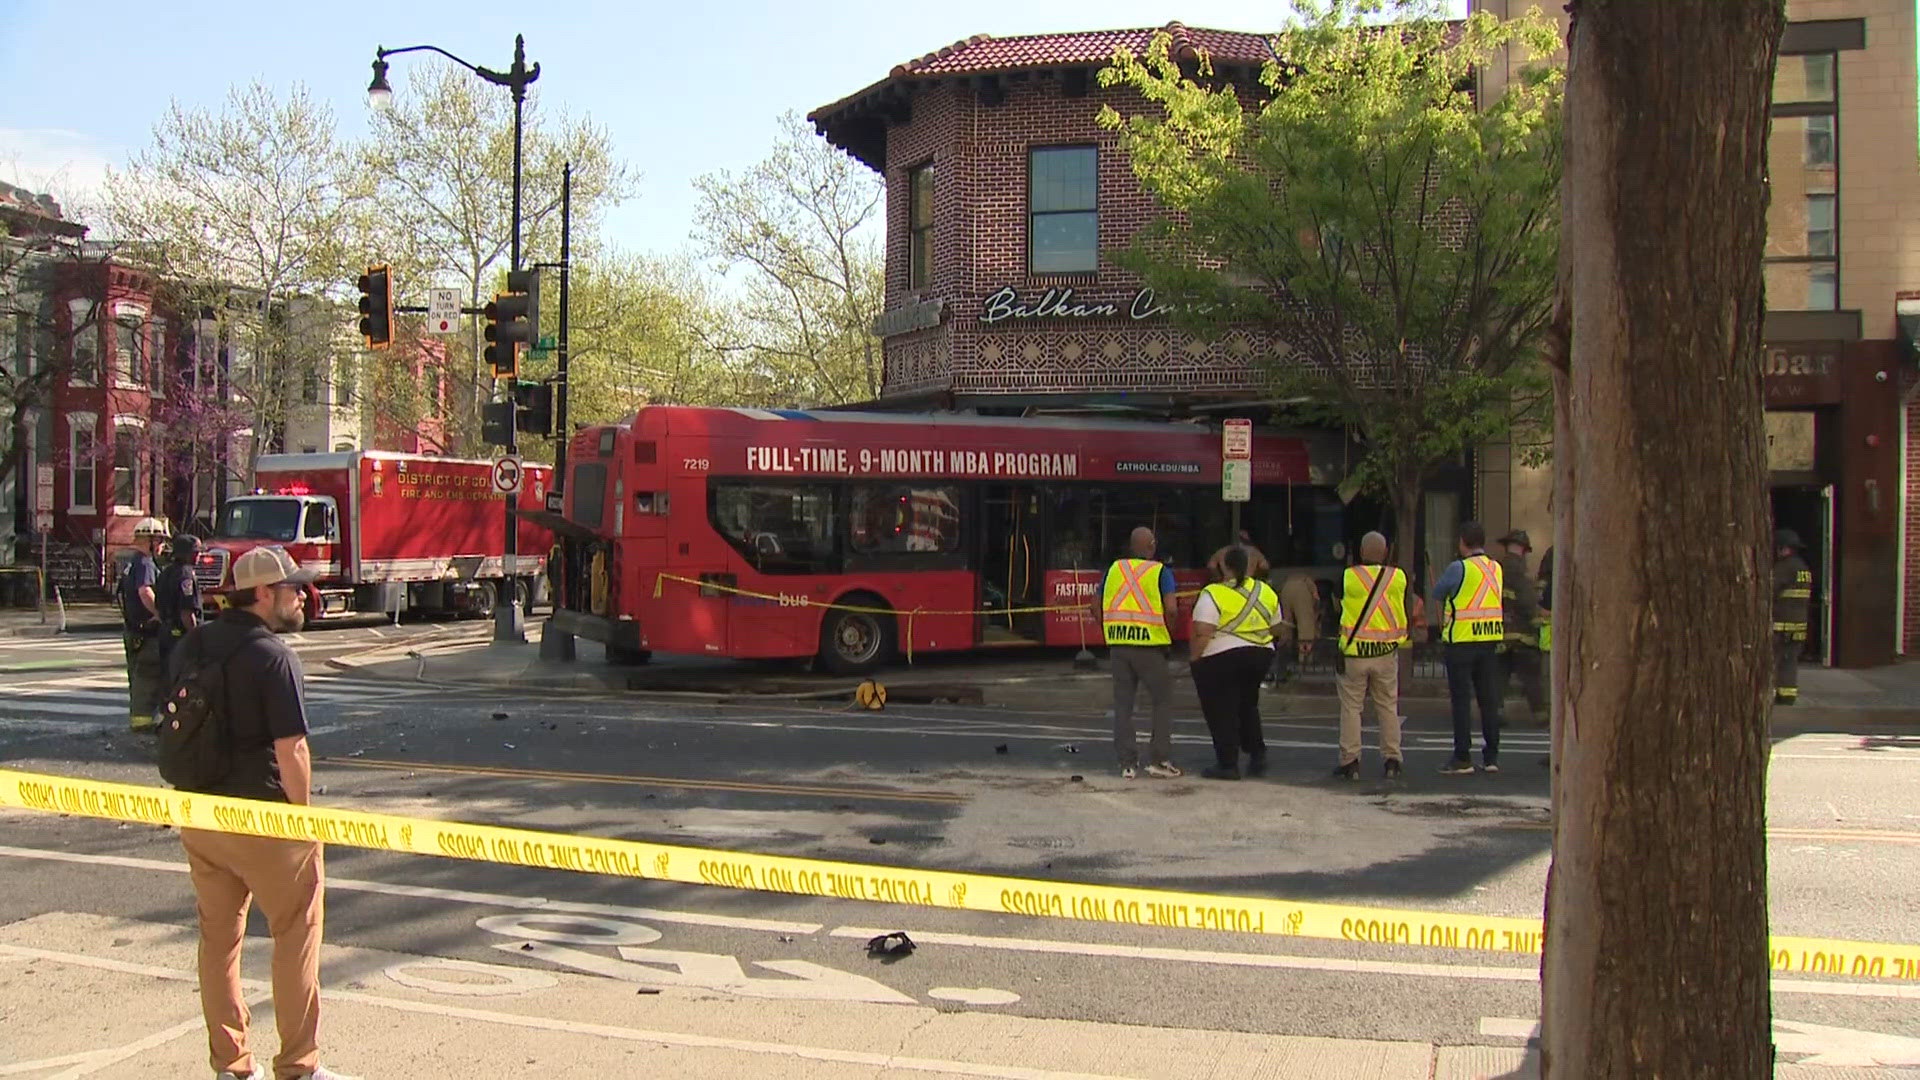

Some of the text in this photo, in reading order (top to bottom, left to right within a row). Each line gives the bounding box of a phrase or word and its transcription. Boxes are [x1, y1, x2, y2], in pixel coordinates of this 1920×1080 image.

[437, 301, 455, 311] TURN
[439, 291, 452, 301] NO
[979, 286, 1118, 323] Balkan
[430, 311, 458, 320] ON RED
[1766, 348, 1836, 375] bar
[683, 458, 709, 471] 7219
[747, 446, 1077, 476] FULL-TIME, 9-MONTH MBA PROGRAM
[1116, 462, 1200, 473] CATHOLIC.EDU/MBA
[397, 473, 493, 488] DISTRICT OF COL
[401, 488, 421, 499] FIRE
[424, 490, 444, 500] AND
[1107, 625, 1151, 641] WMATA
[18, 780, 174, 824] POLICE LINE DO NOT CROSS
[213, 804, 391, 849] POLICE LINE DO NOT CROSS
[437, 831, 644, 877] POLICE LINE DO NOT CROSS
[698, 859, 935, 906] POLICE LINE DO NOT CROSS
[1000, 888, 1264, 934] POLICE LINE DO NOT CROSS
[1340, 917, 1543, 953] INE DO NOT CROSS
[1801, 950, 1844, 974] NOT
[1851, 954, 1885, 978] DO
